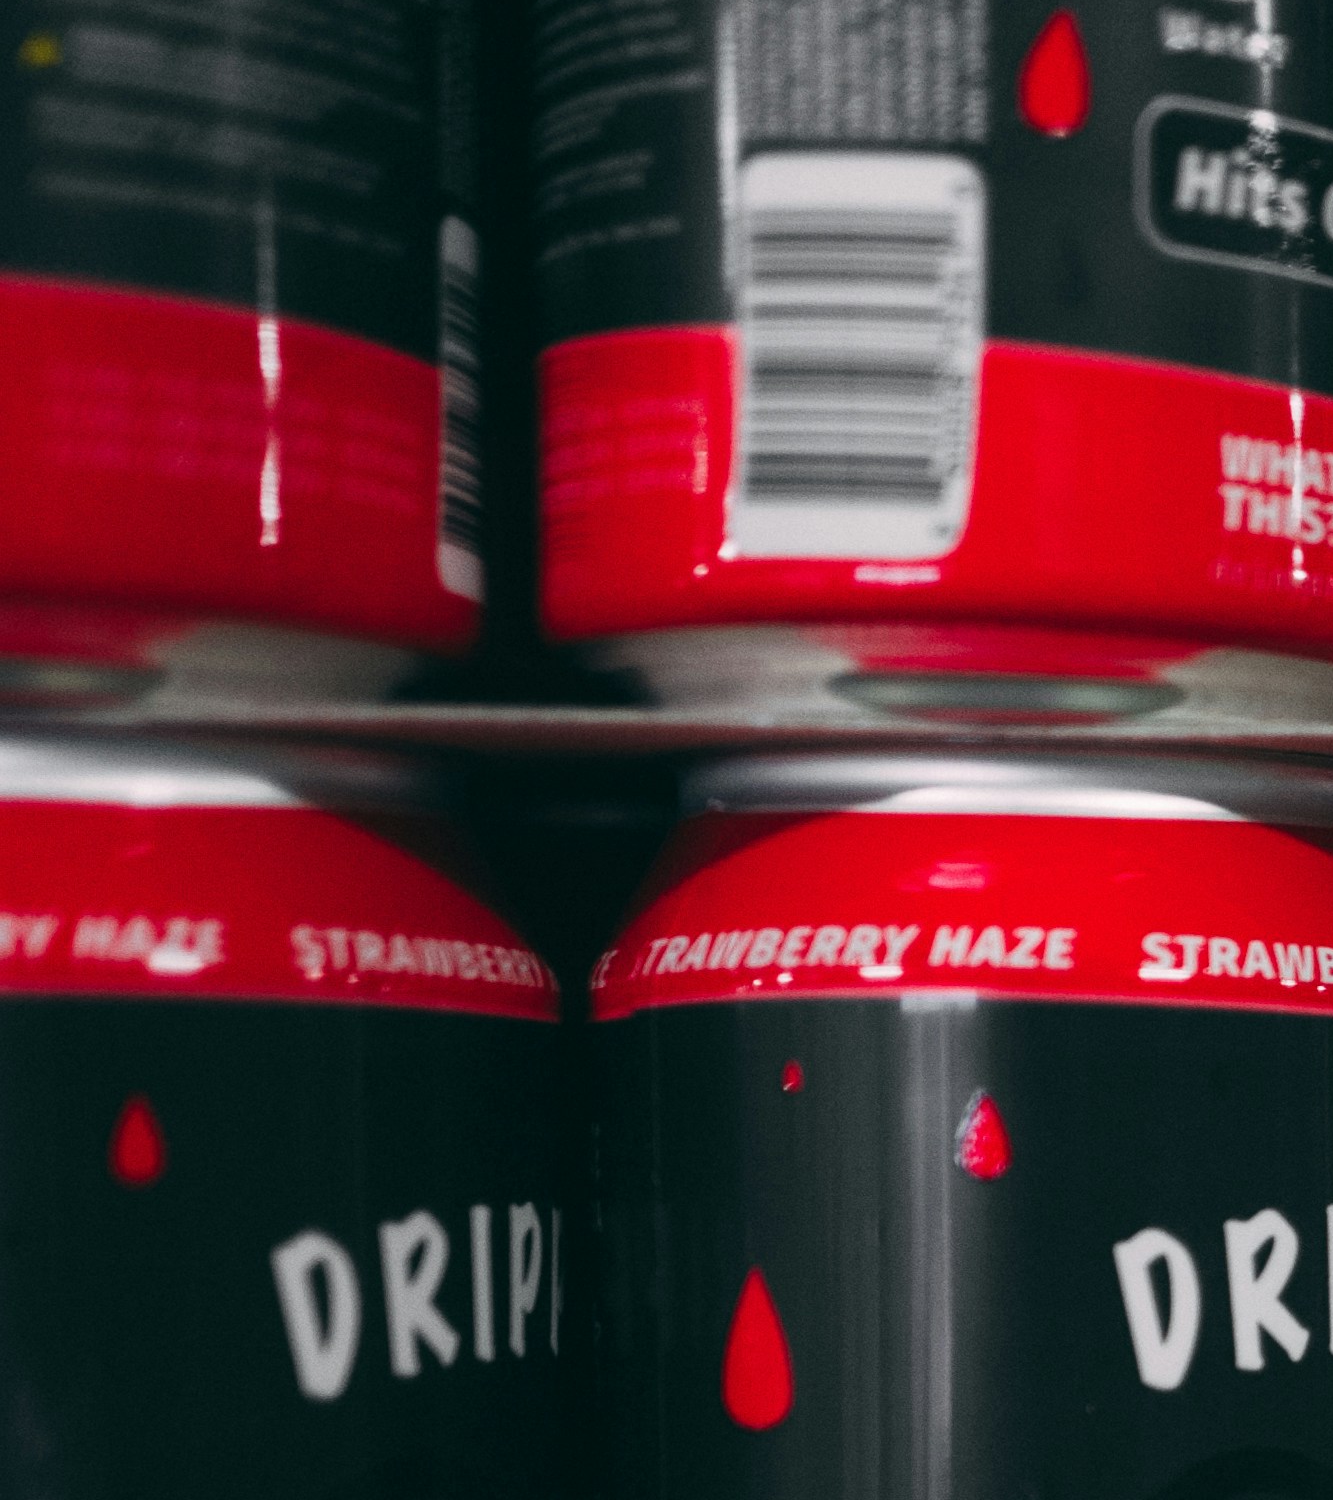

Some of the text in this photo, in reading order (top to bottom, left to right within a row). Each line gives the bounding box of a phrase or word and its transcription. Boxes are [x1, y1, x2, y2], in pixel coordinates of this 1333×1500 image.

[1173, 147, 1309, 225] Hits
[290, 923, 546, 989] STRAWBERRY
[929, 928, 1077, 971] HAZE
